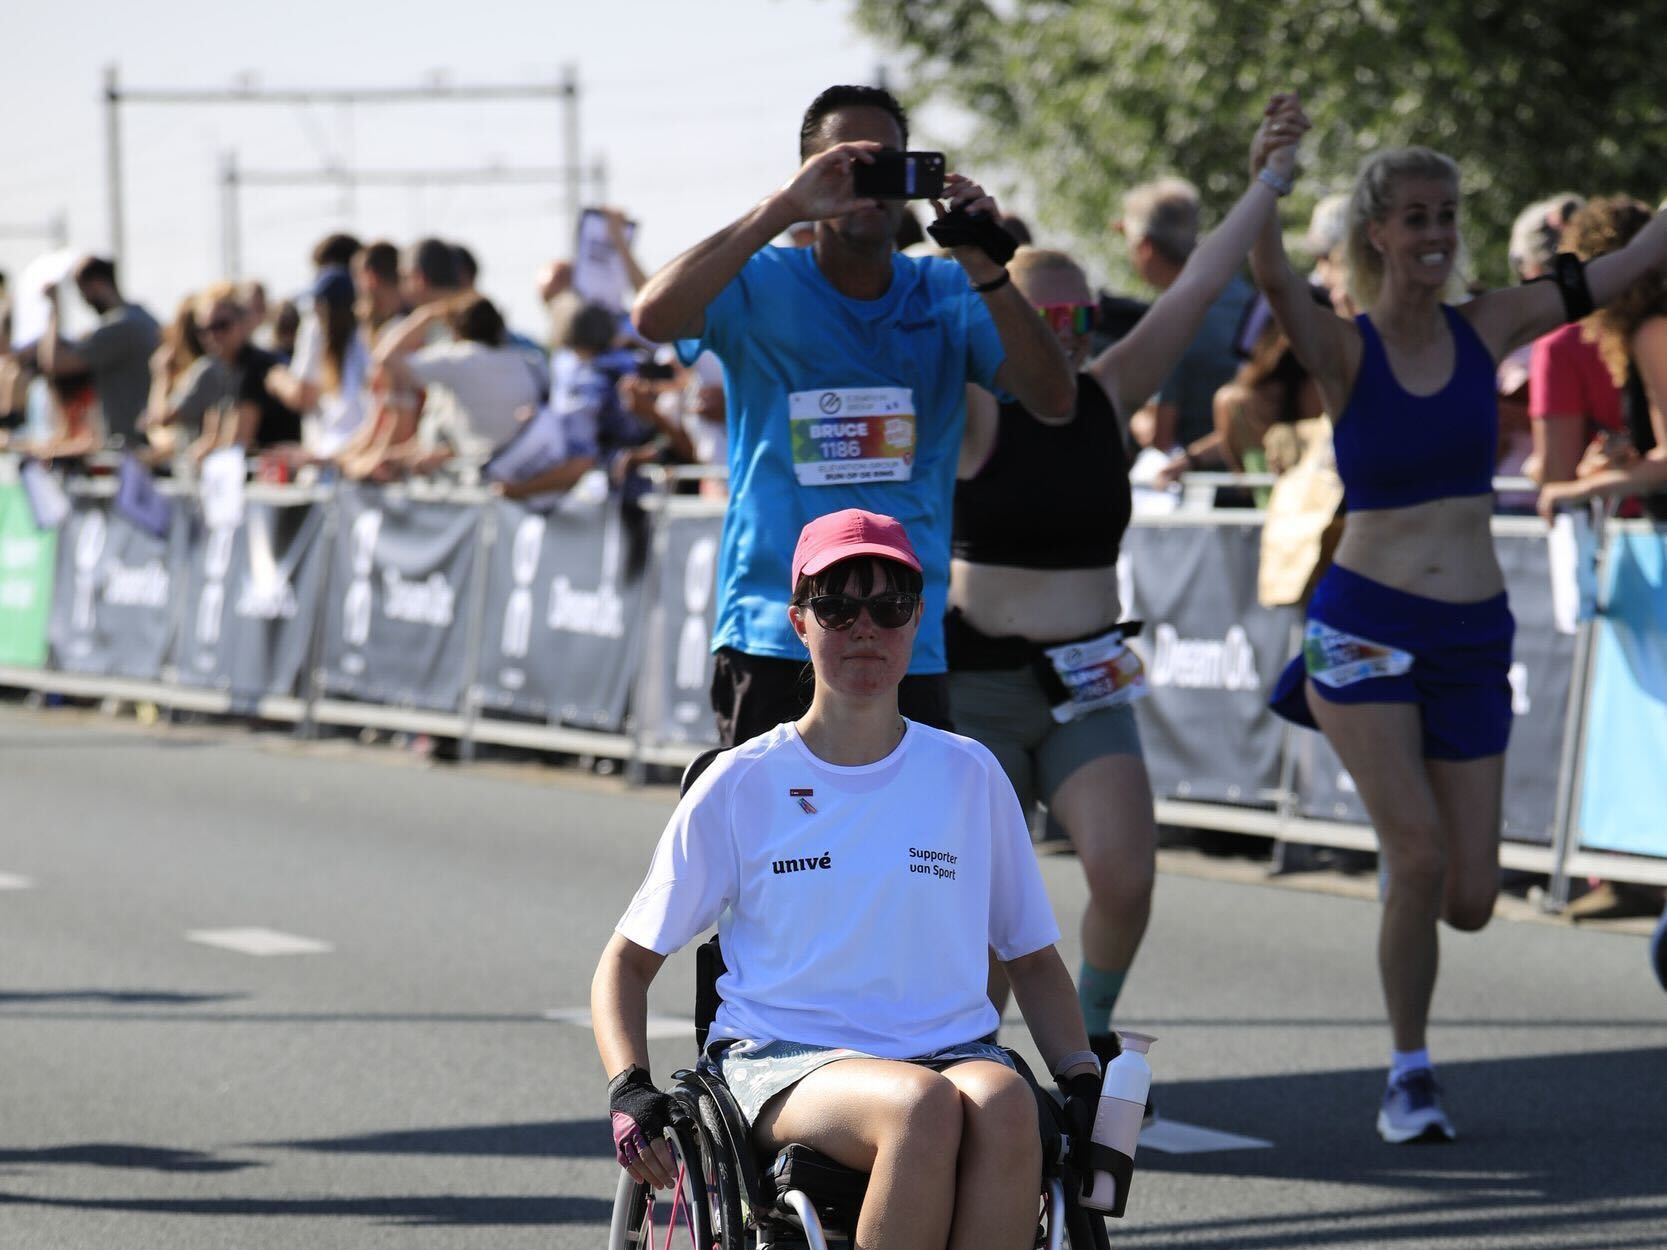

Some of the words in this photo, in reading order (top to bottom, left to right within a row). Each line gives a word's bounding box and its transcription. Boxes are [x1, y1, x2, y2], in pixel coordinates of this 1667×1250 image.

[809, 422, 869, 439] BRUCE
[820, 441, 862, 458] 1186
[772, 851, 832, 875] univé
[908, 847, 958, 865] Supporter
[932, 864, 956, 881] Sport
